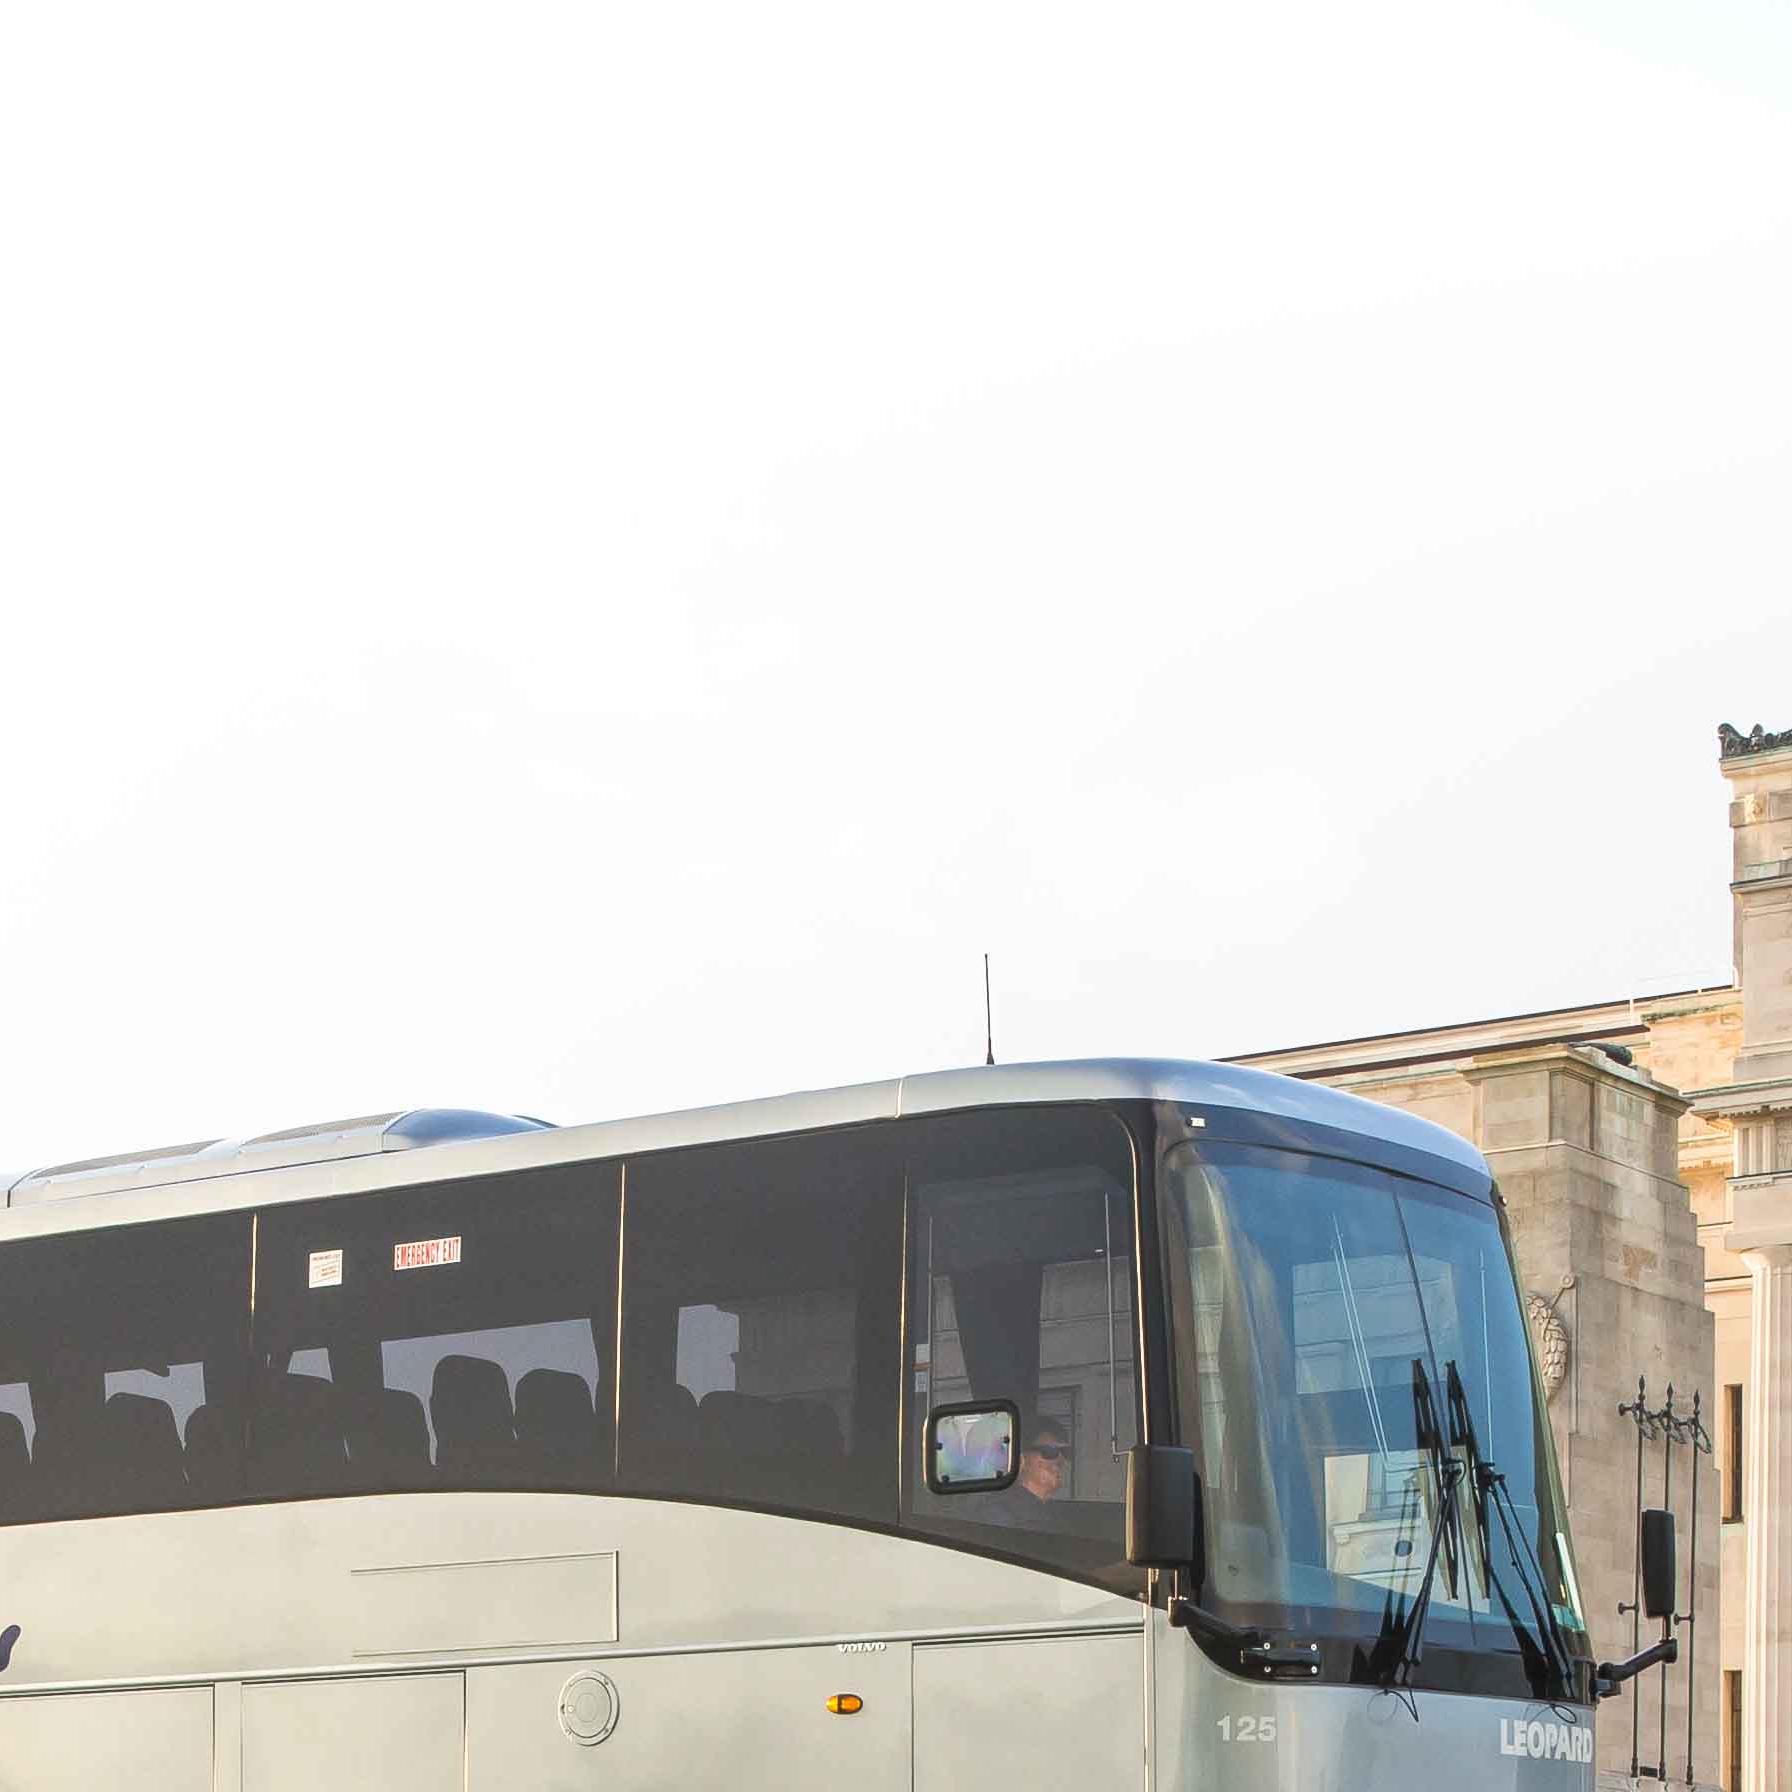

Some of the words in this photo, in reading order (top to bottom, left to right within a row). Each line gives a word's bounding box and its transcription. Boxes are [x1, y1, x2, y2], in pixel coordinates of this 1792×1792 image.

[396, 1242, 440, 1268] EMERGENCY
[838, 1641, 887, 1653] VOLVO
[1216, 1715, 1277, 1742] 125
[1500, 1719, 1593, 1763] LEOPARD
